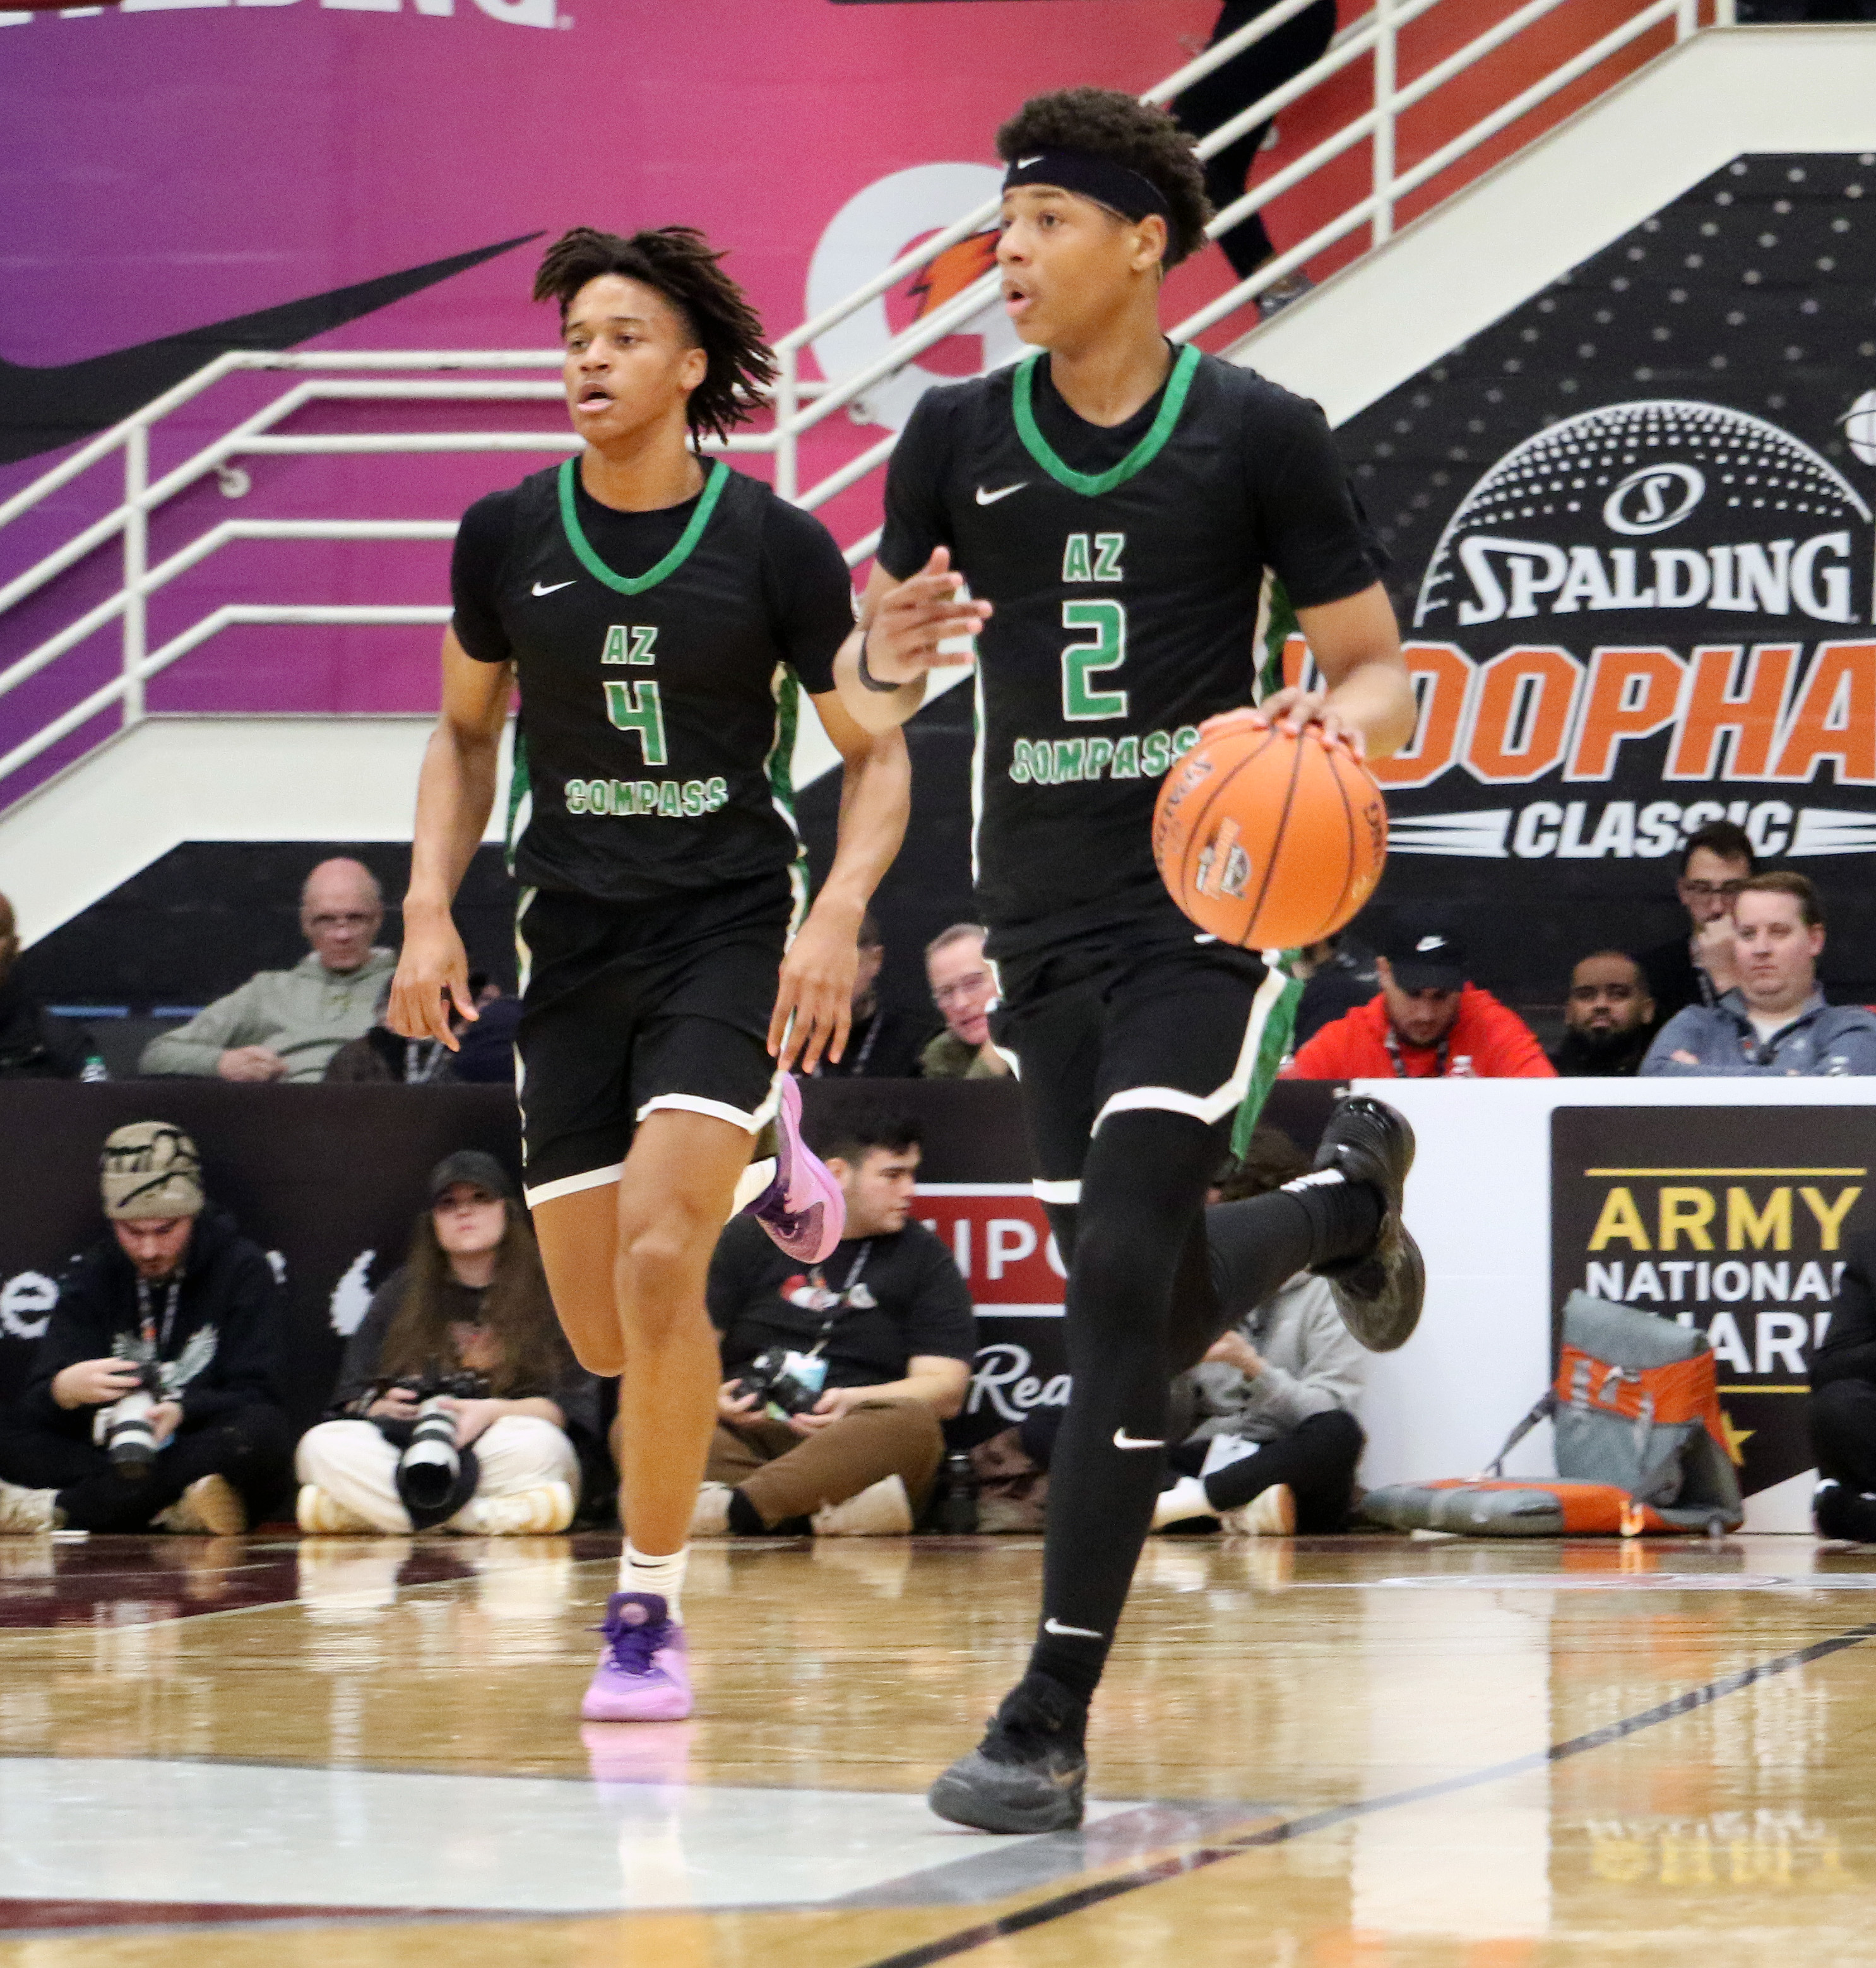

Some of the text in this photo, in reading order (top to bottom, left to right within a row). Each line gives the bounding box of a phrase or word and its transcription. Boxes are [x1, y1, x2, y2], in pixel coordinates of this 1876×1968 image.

[1062, 532, 1124, 582] AZ
[1459, 530, 1852, 625] SPALDING
[601, 625, 658, 665] AZ
[1060, 598, 1128, 721] 2
[602, 680, 668, 766] 4
[1009, 725, 1201, 785] COMPASS
[565, 776, 728, 817] COMPASS
[1587, 1186, 1864, 1252] ARMY
